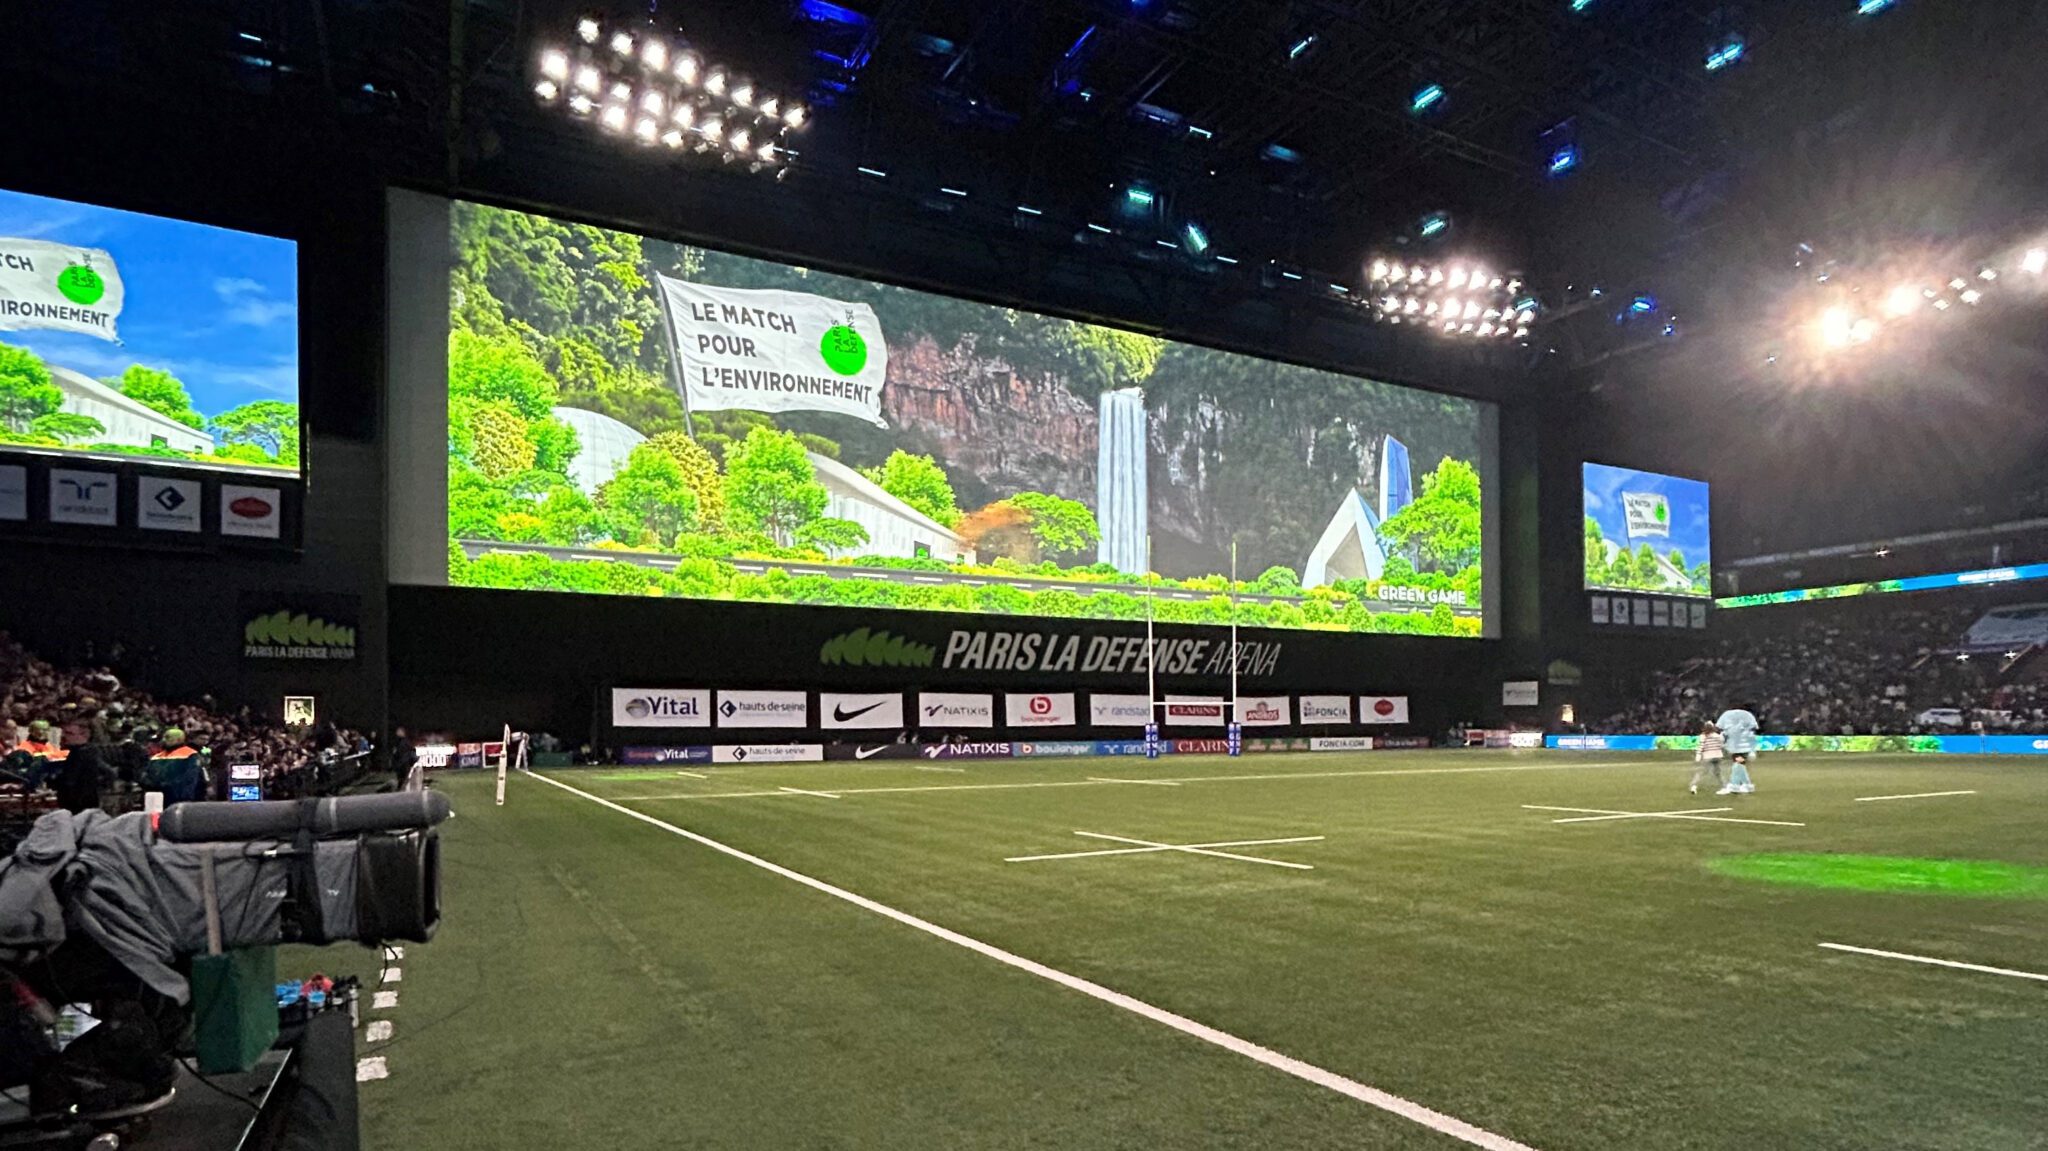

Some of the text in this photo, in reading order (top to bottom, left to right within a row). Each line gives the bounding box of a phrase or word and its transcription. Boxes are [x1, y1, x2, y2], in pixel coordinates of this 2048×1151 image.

[692, 302, 797, 334] LE MATCH
[831, 320, 843, 352] PARIS
[845, 309, 858, 354] DEFENSE
[697, 334, 757, 358] POUR
[843, 339, 851, 353] LA
[702, 367, 872, 404] L'ENVIRONNEMENT
[1379, 585, 1466, 605] GREEN GAME
[245, 645, 274, 658] PARIS
[275, 646, 288, 658] LA
[288, 646, 328, 659] DEFENSE
[942, 630, 1281, 676] PARIS LA DEFENSE ARENA
[648, 697, 699, 715] Vital
[943, 707, 989, 716] NATIXIS
[1171, 705, 1218, 715] CLARINS
[1315, 708, 1347, 716] FONCIA
[1247, 710, 1279, 720] ANDROS
[950, 743, 1010, 755] NATIXIS
[1036, 743, 1090, 754] boulanger
[1178, 740, 1230, 752] CLARIN
[664, 748, 689, 759] Vital
